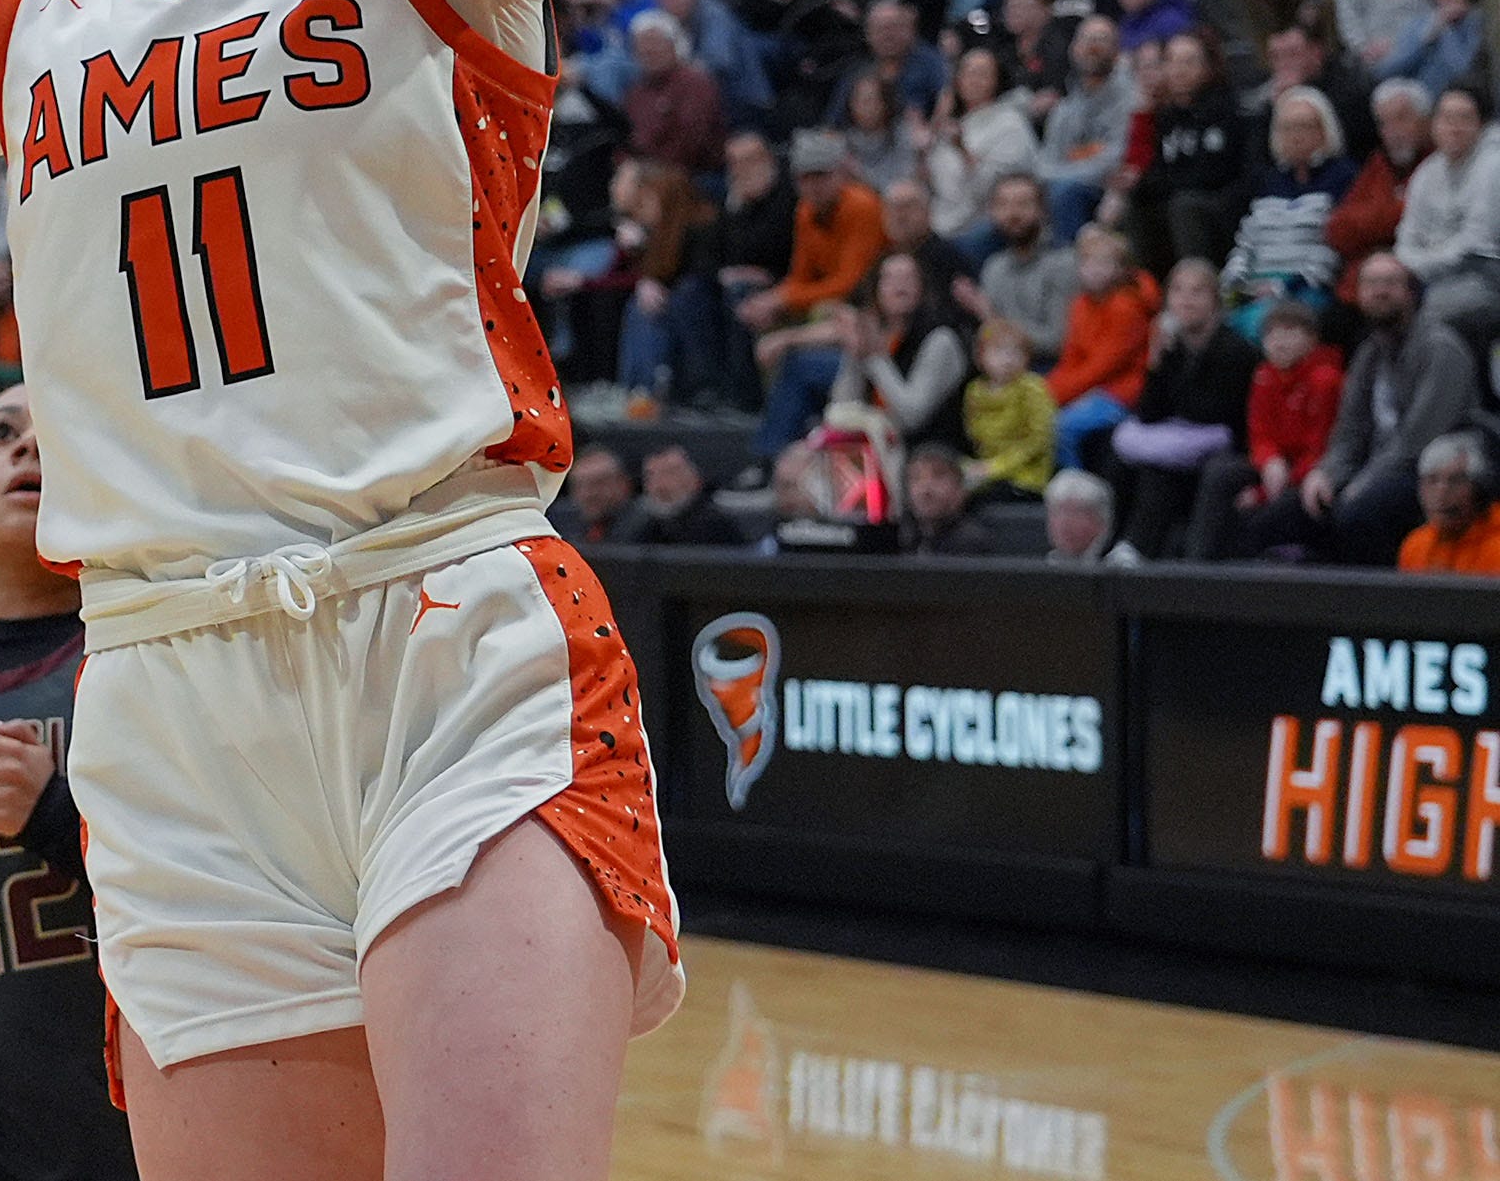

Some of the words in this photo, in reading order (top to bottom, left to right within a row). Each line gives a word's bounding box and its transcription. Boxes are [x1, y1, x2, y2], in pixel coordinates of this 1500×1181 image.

[118, 166, 275, 401] 11
[1320, 635, 1490, 717] AMES
[783, 677, 901, 759] LITTLE
[904, 684, 1104, 775] CYCLONES
